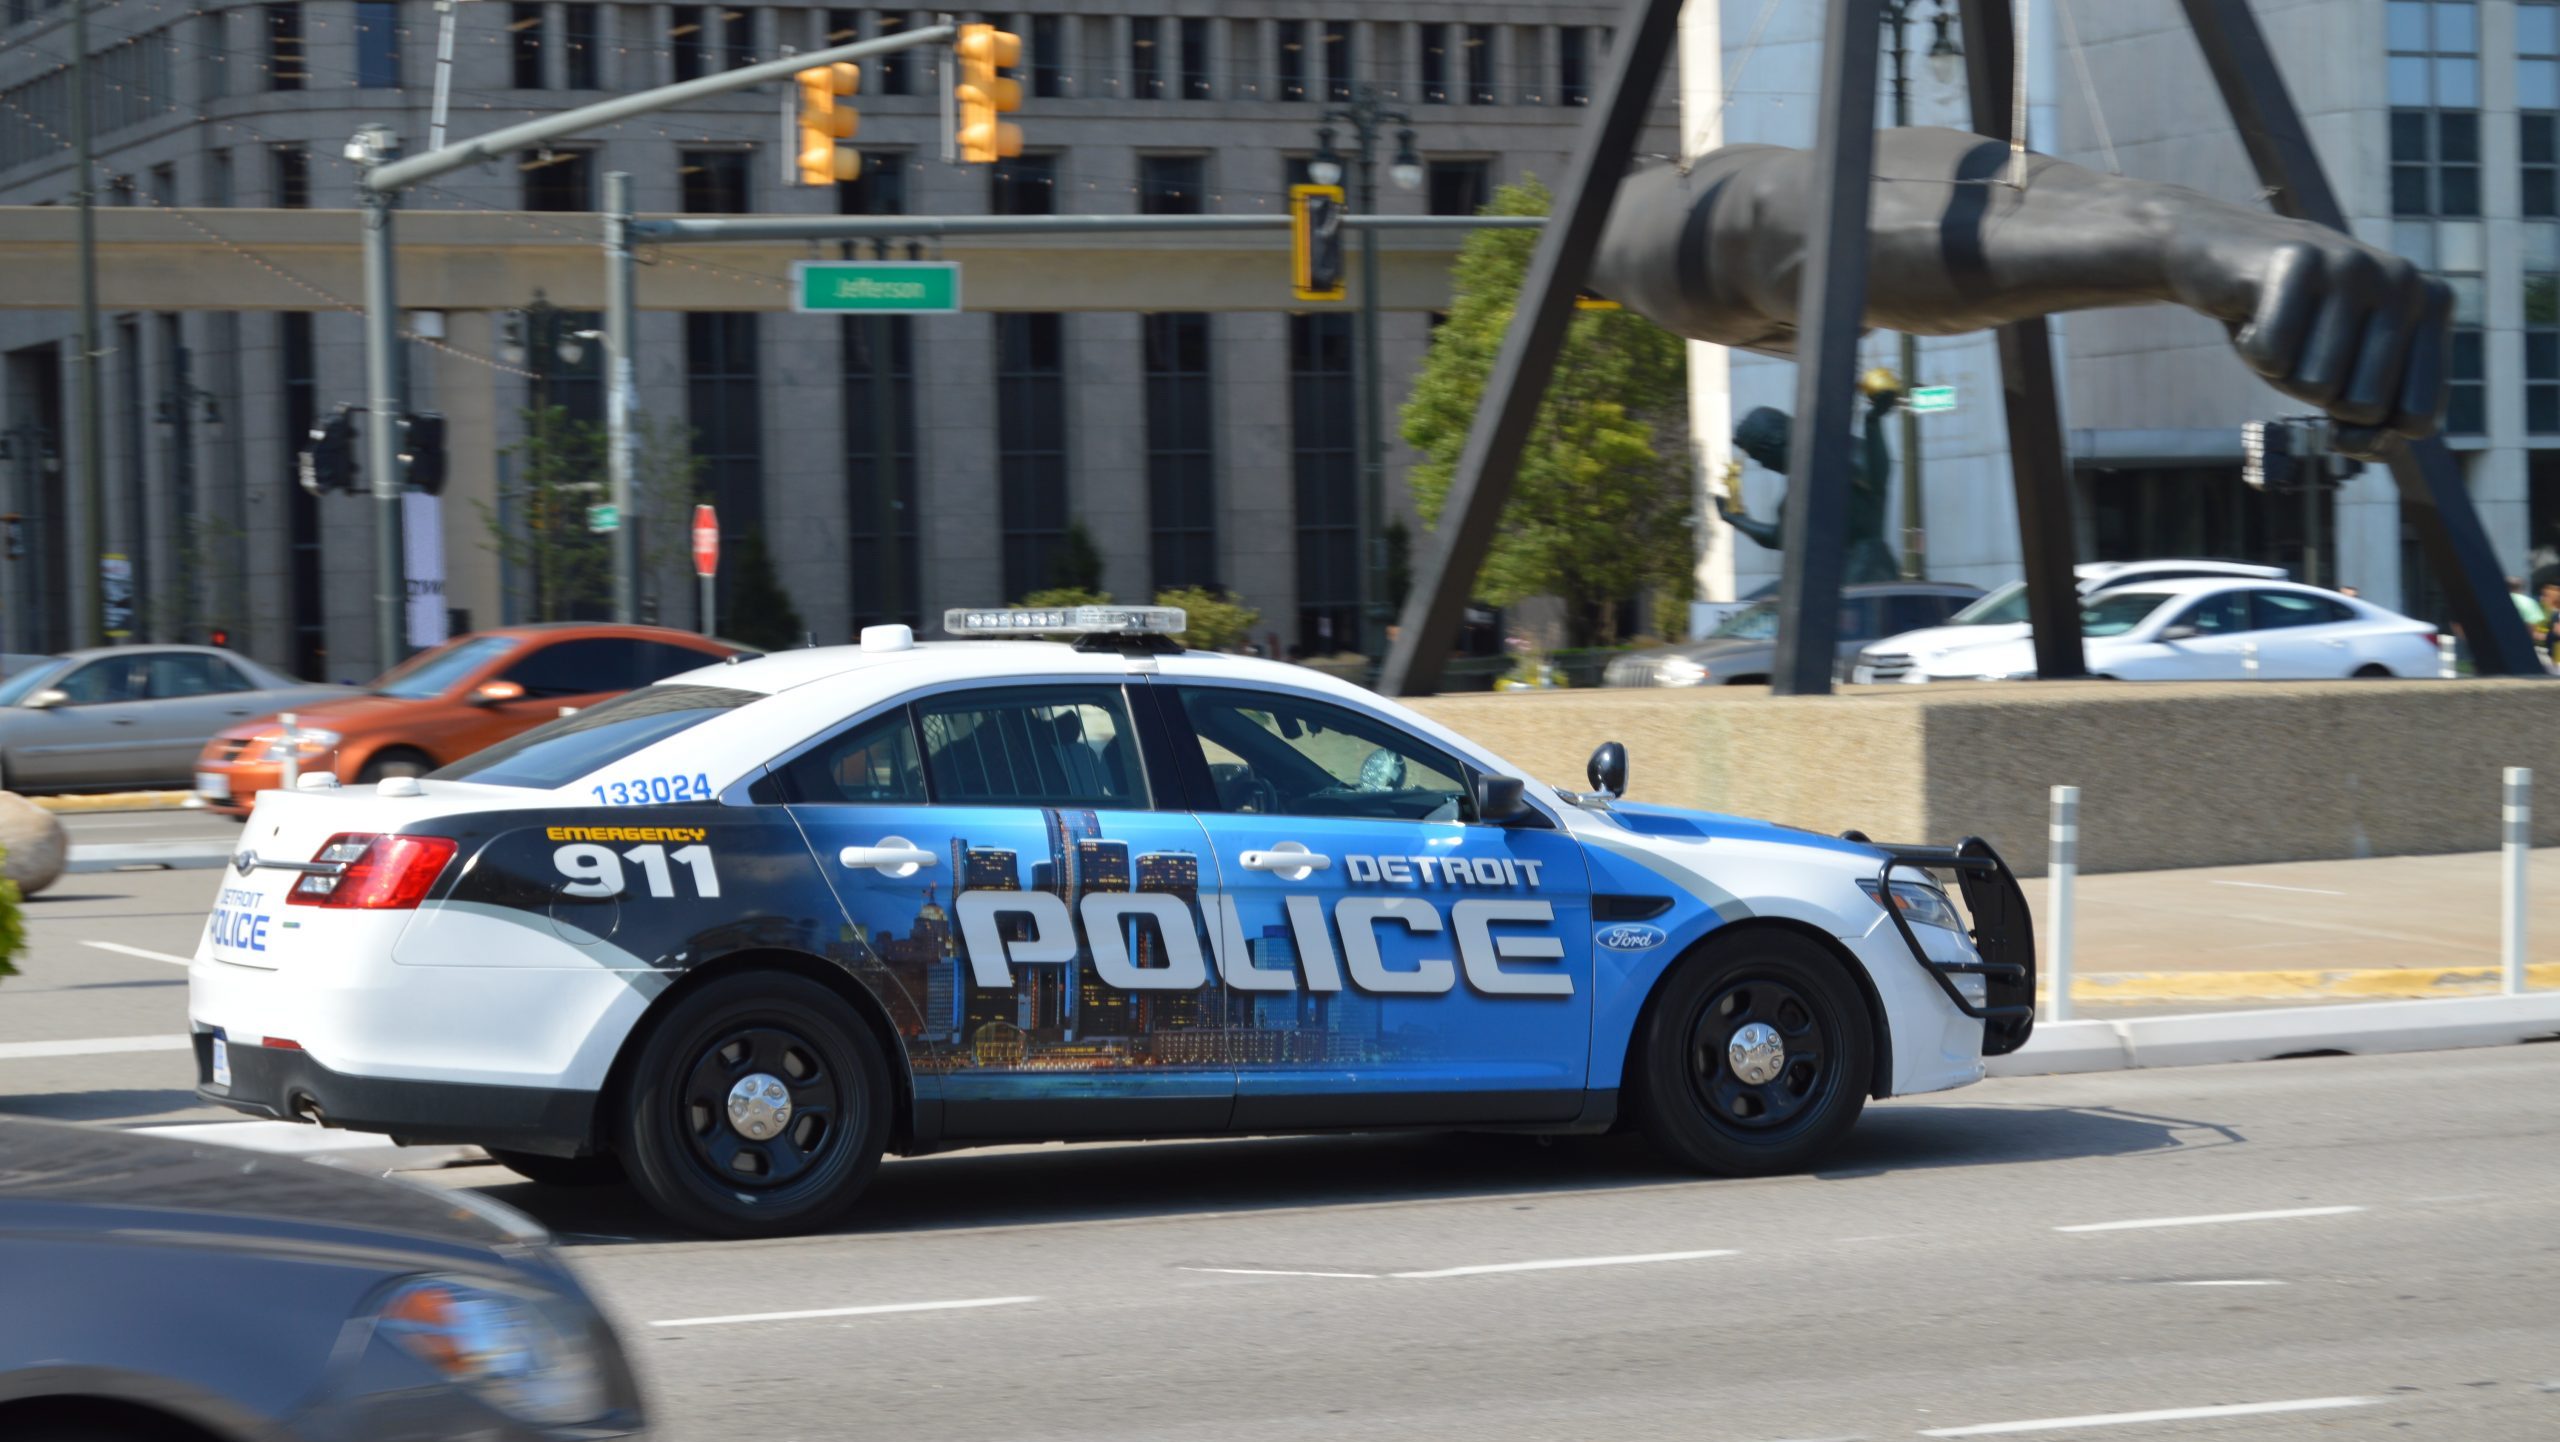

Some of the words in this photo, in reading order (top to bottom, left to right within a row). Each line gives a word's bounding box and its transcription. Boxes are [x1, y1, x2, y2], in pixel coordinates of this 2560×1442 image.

[832, 277, 926, 299] Jefferson
[592, 773, 712, 805] 133024
[546, 826, 706, 842] EMERGENCY
[553, 843, 721, 898] 911
[1345, 855, 1543, 887] DETROIT
[956, 891, 1575, 994] POLICE
[1608, 928, 1653, 947] Ford
